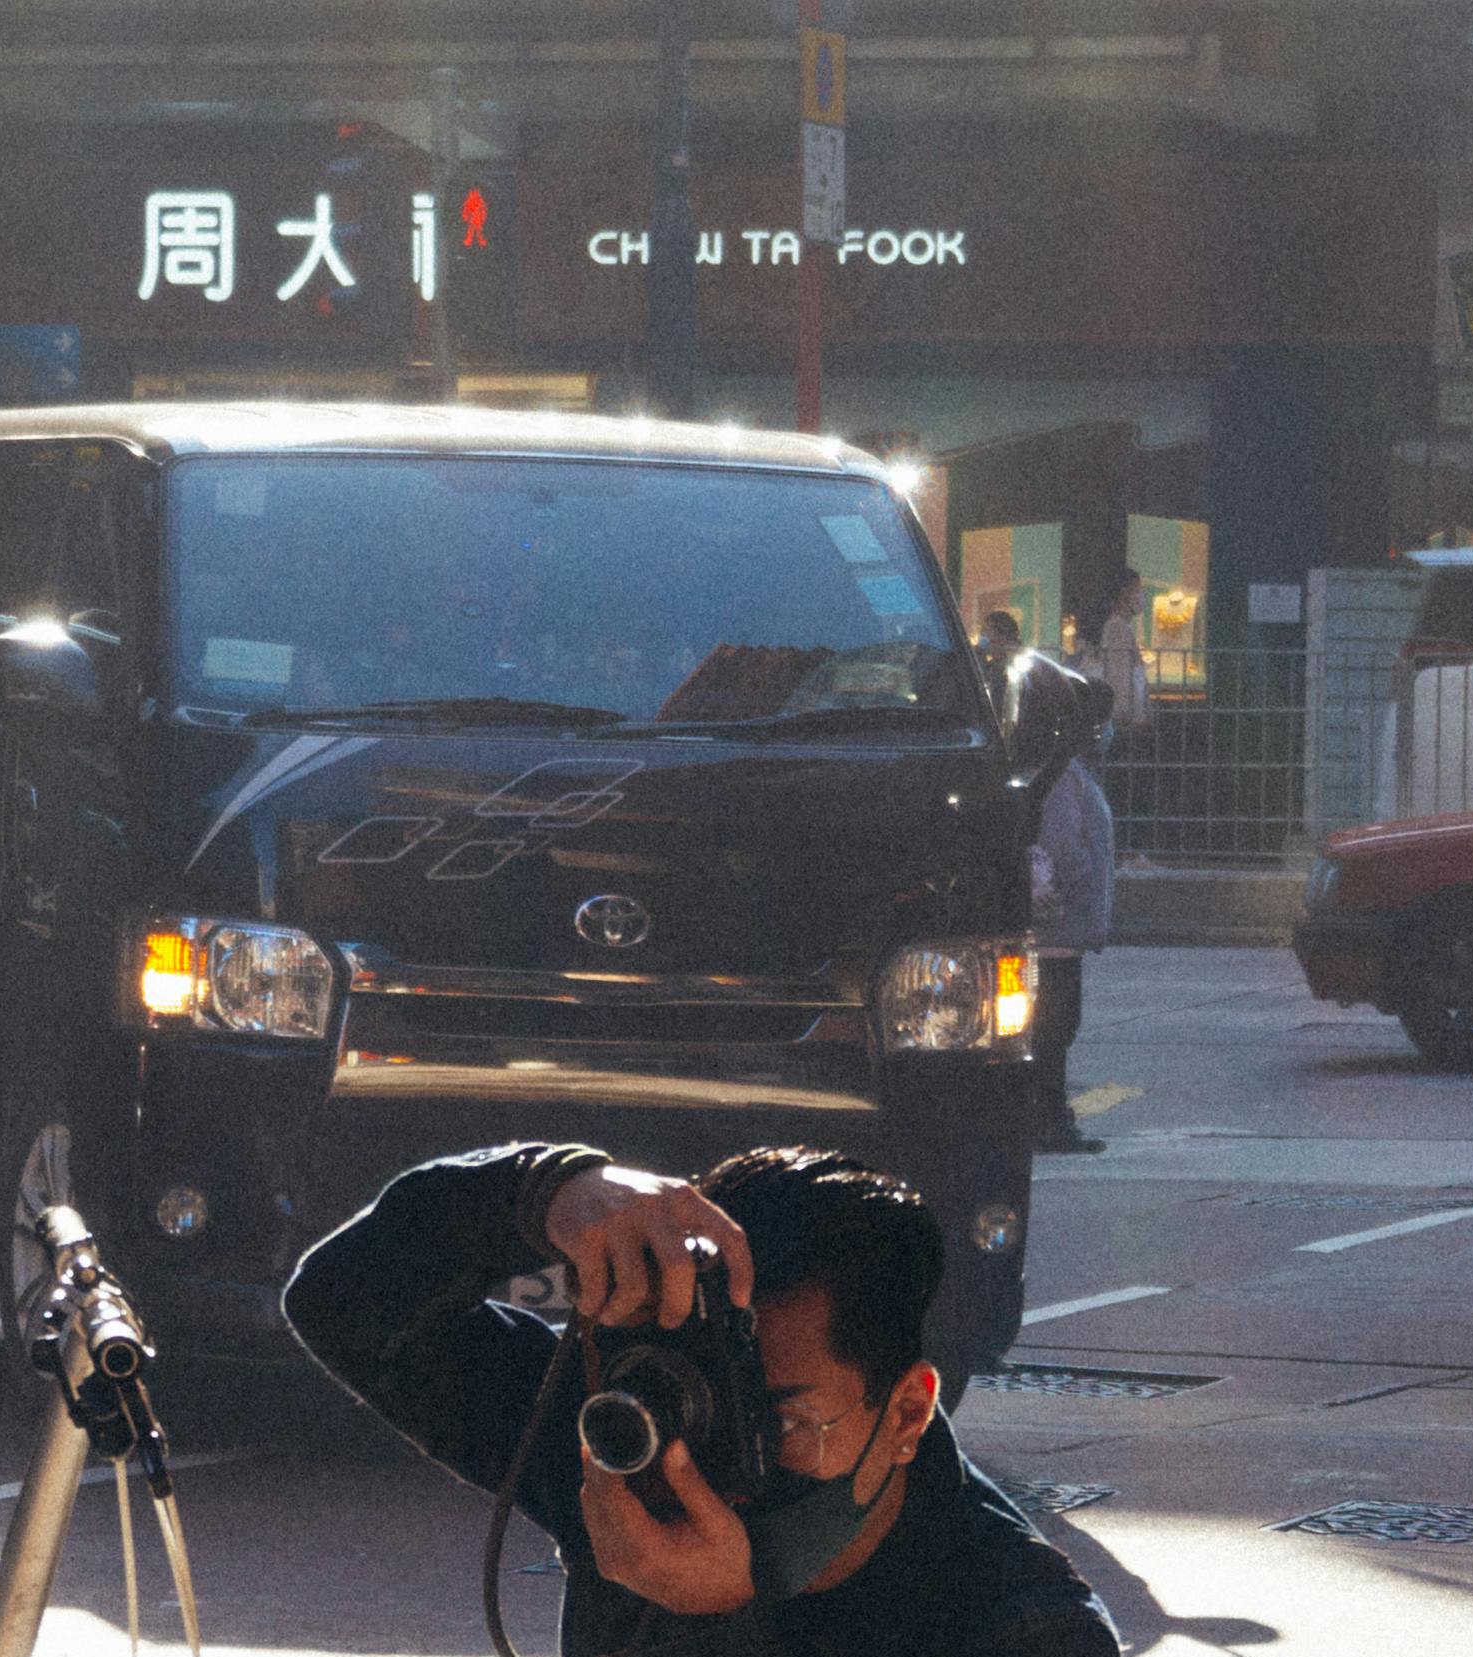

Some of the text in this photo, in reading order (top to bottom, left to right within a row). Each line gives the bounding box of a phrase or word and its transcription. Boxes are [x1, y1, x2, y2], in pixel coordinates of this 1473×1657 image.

[587, 230, 967, 266] CHW TA FOOK
